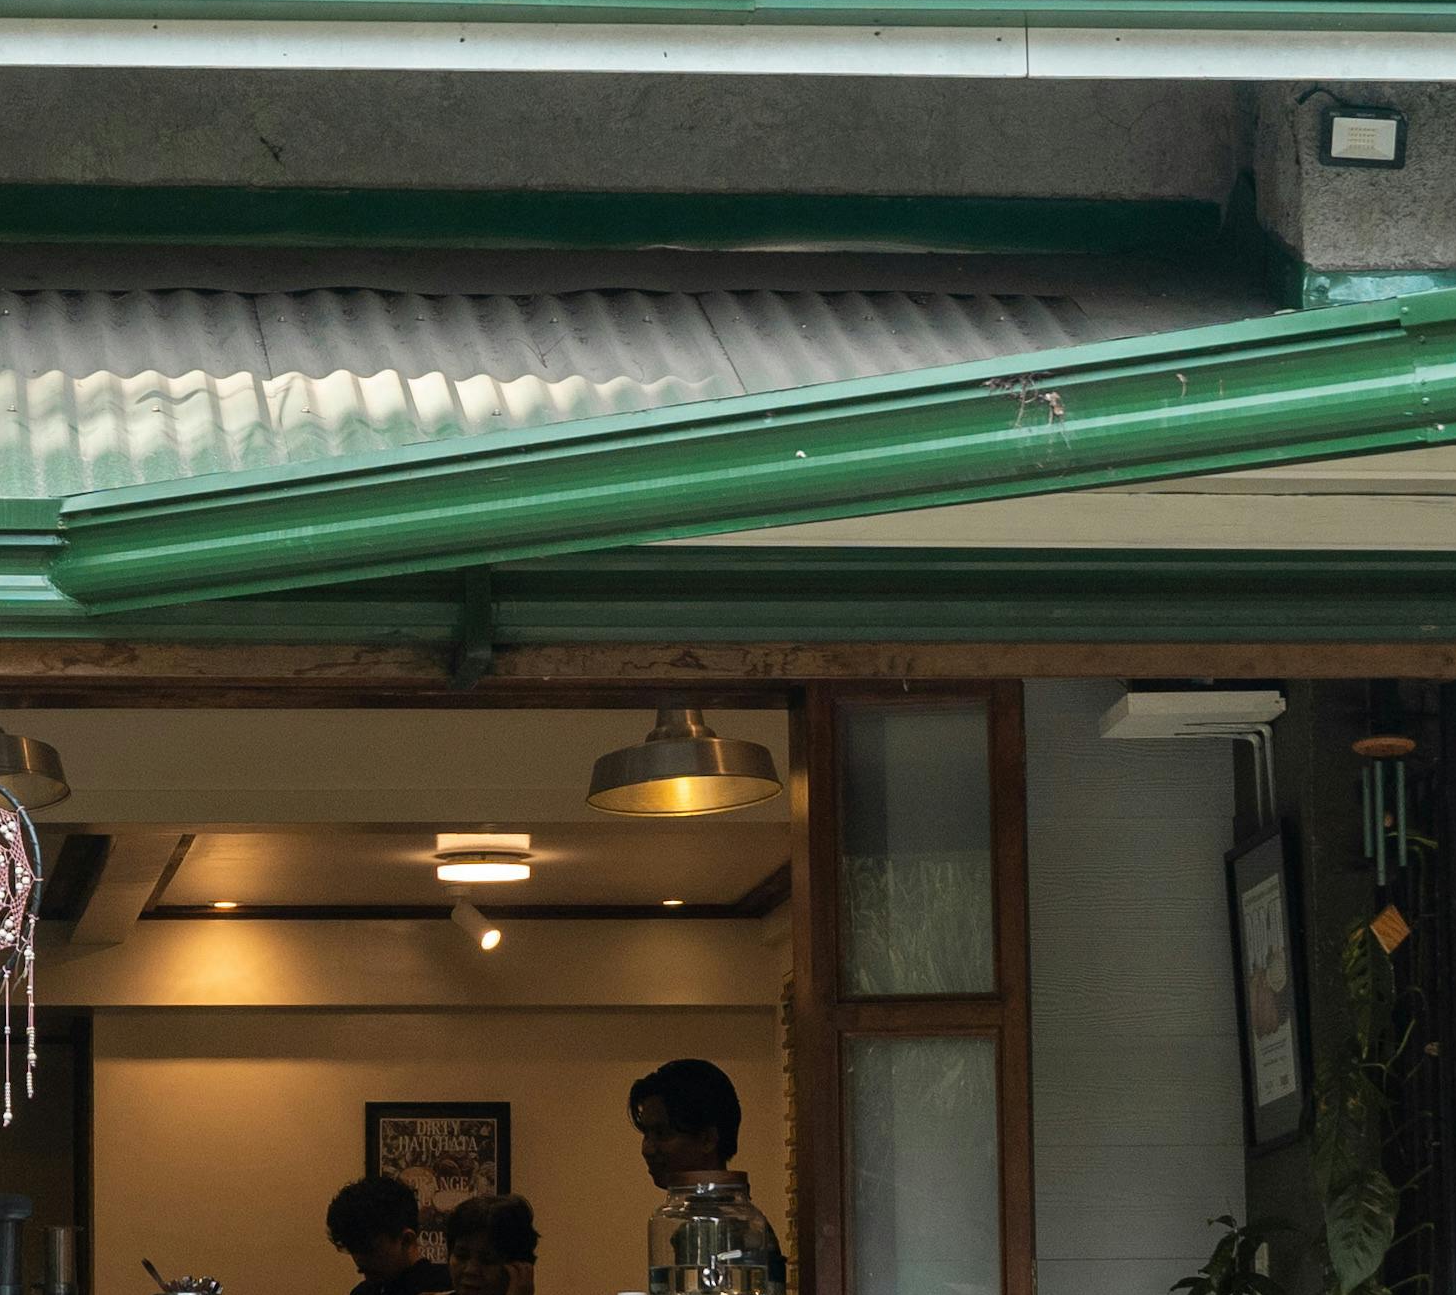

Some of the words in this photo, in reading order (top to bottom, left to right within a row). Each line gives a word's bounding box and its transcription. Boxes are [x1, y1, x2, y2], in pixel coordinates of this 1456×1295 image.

[416, 1120, 461, 1136] DIRTY
[398, 1136, 478, 1157] HATCHATA
[419, 1231, 447, 1246] COL
